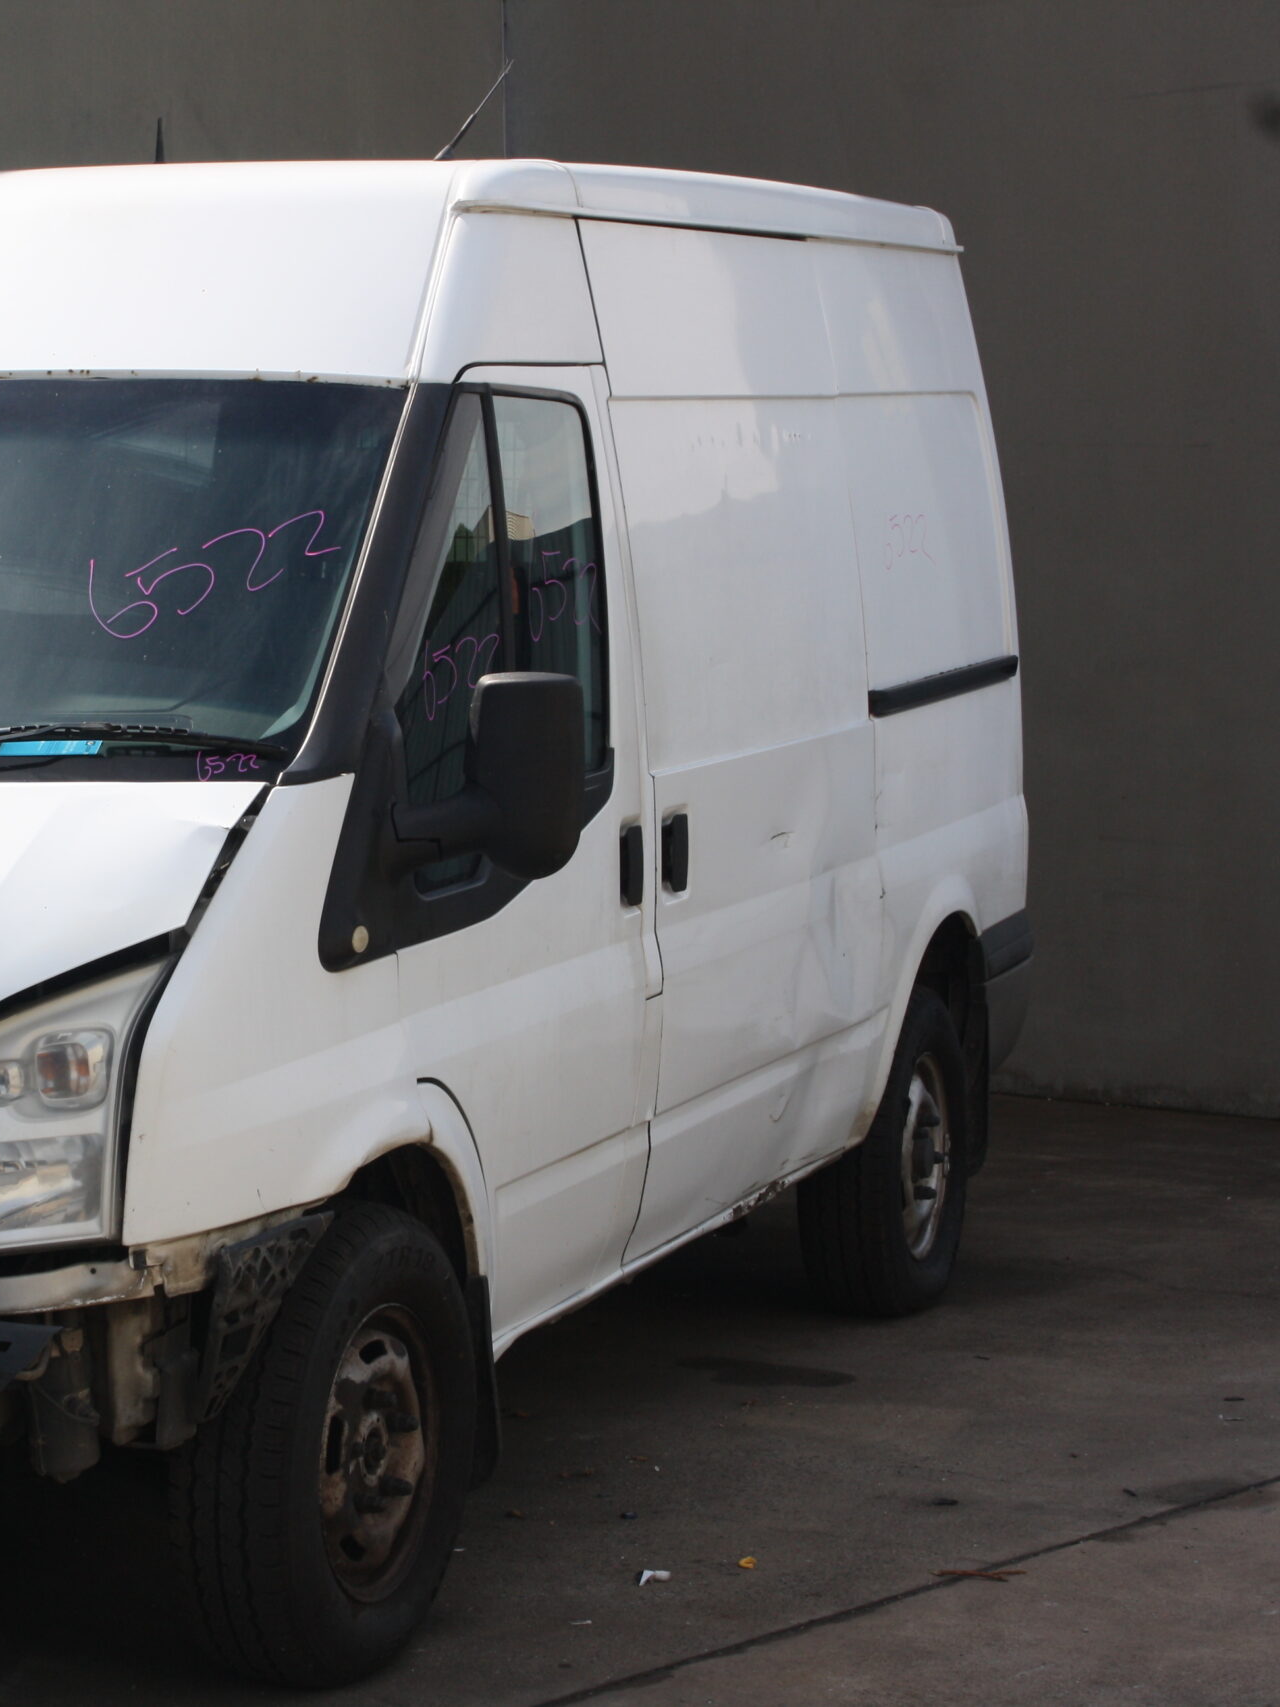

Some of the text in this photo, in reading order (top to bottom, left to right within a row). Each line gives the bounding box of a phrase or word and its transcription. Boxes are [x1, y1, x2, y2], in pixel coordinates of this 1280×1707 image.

[89, 510, 342, 639] 6522
[423, 633, 500, 721] 6522
[195, 750, 260, 782] 6522
